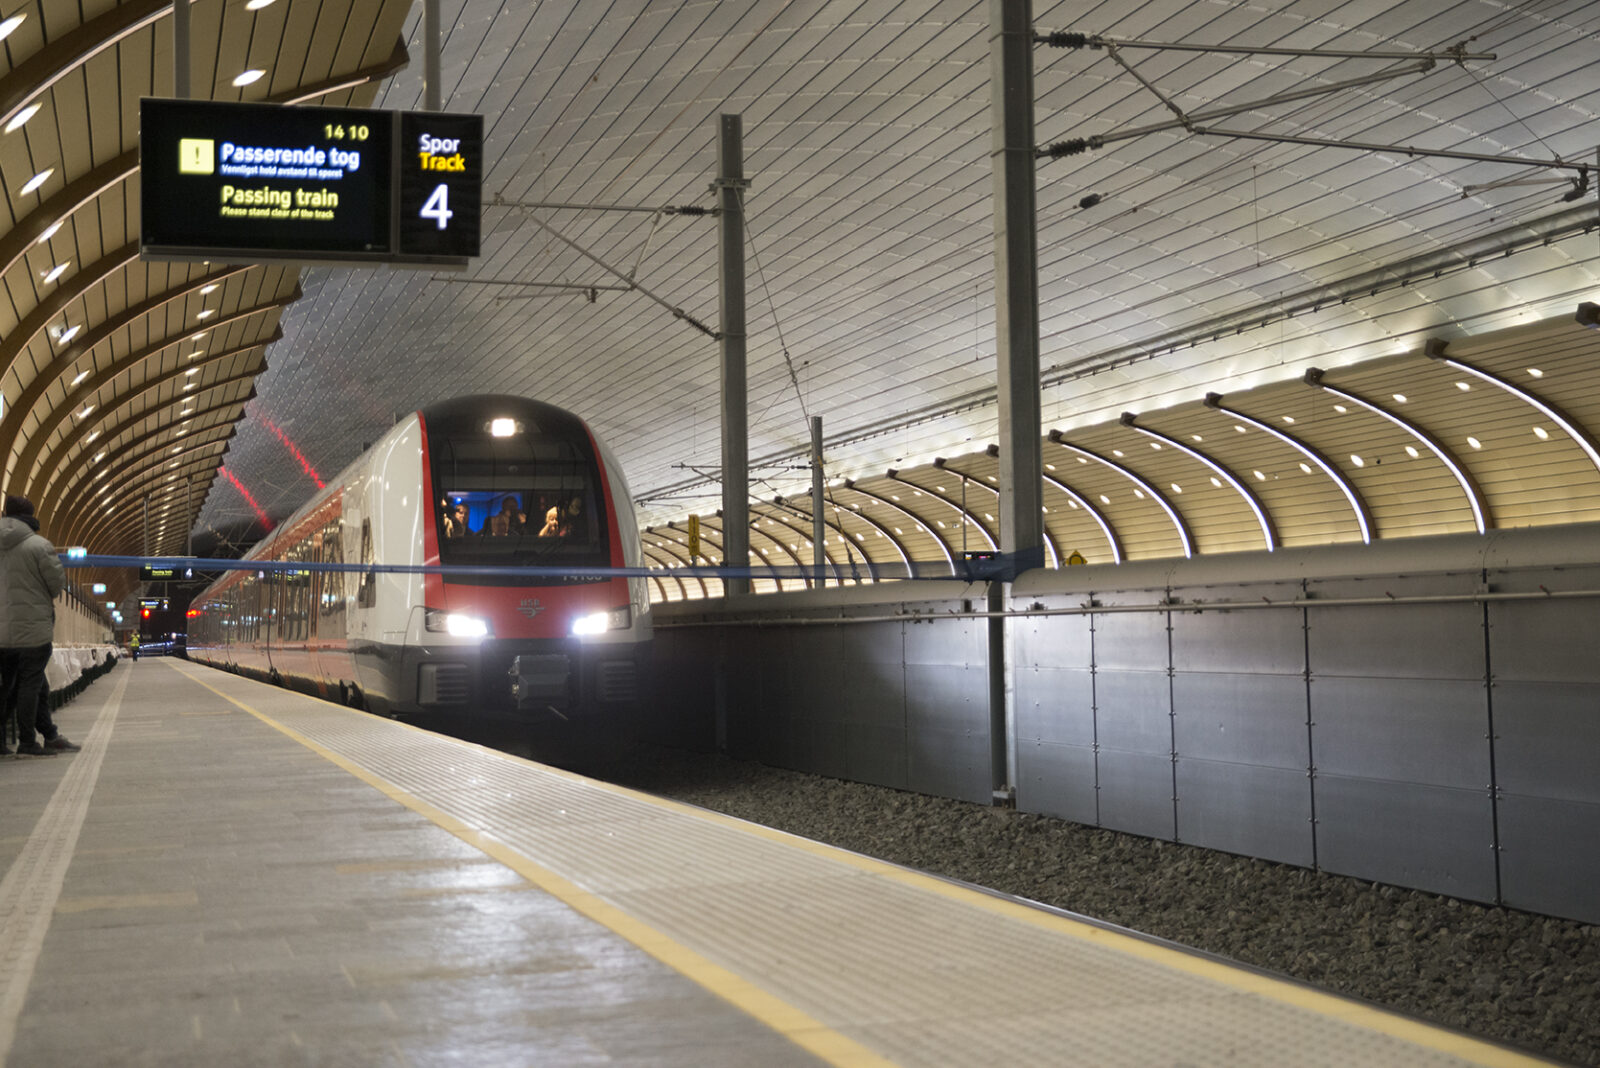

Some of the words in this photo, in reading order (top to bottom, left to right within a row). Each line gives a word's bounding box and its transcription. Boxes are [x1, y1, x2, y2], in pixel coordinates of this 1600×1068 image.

[325, 124, 345, 140] 14
[349, 125, 369, 141] 10
[419, 133, 460, 155] Spor
[221, 142, 326, 166] Passerende
[329, 147, 360, 172] tog
[419, 152, 466, 173] Track
[221, 164, 258, 177] Vennligst
[259, 165, 277, 176] hold
[278, 166, 308, 177] avstand
[308, 167, 318, 177] til
[319, 168, 343, 180] sporet
[221, 185, 292, 209] Passing
[296, 187, 339, 208] train
[420, 183, 453, 230] 4
[221, 206, 247, 217] Please
[248, 207, 270, 217] stand
[271, 208, 290, 218] clear
[291, 208, 300, 218] of
[300, 209, 313, 219] the
[314, 209, 335, 220] track
[186, 568, 193, 577] 4
